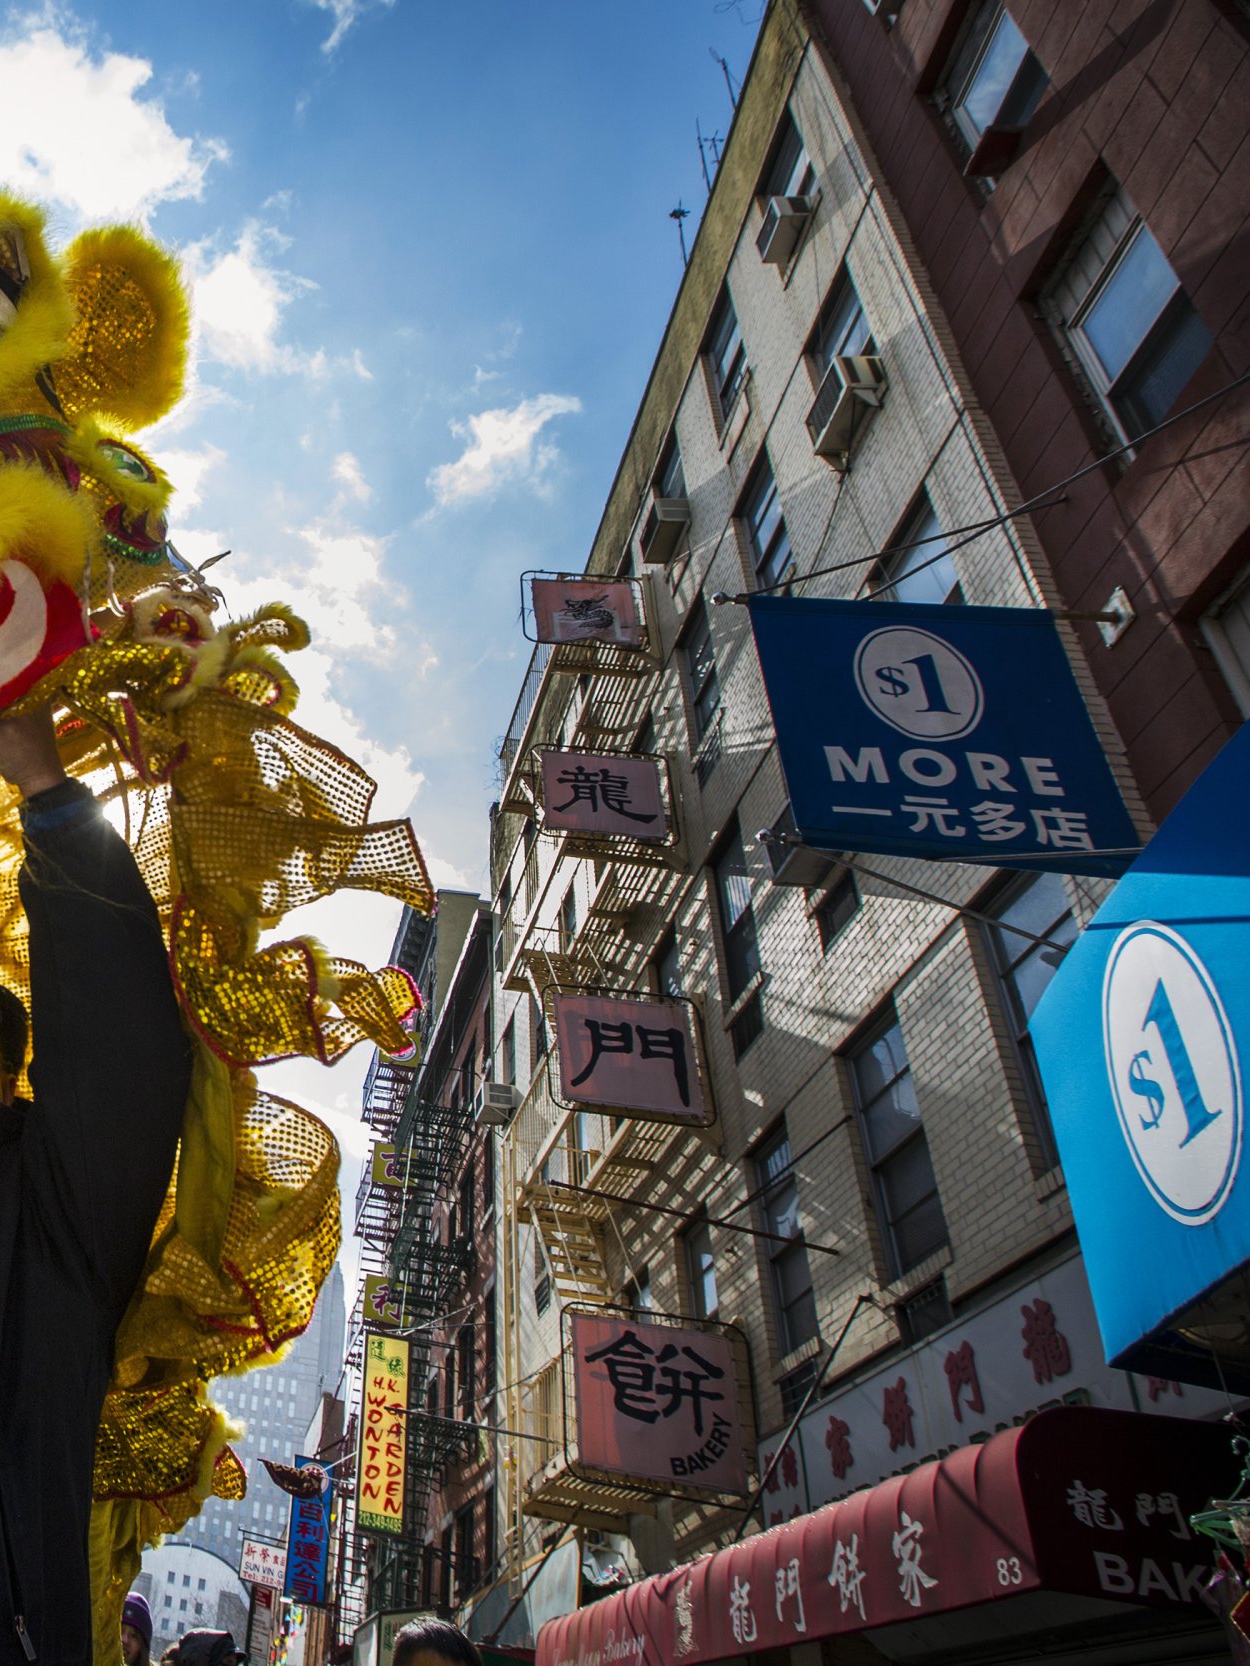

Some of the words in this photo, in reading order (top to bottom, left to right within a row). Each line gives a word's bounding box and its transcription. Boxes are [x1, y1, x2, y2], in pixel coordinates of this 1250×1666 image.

[874, 654, 961, 715] $1
[551, 765, 657, 824] 龍
[823, 745, 1065, 796] MORE
[832, 795, 1094, 850] 一元多店
[570, 1017, 690, 1108] 門
[1129, 977, 1222, 1149] $1
[584, 1330, 725, 1437] 餅
[362, 1392, 386, 1500] WONTON
[384, 1403, 405, 1515] GARDEN
[671, 1411, 733, 1476] BAKERY
[244, 1562, 260, 1574] SUN
[262, 1565, 273, 1577] VIN
[293, 1500, 324, 1603] 百利達公司
[729, 1511, 939, 1645] 龍門餅家
[996, 1557, 1023, 1586] 83
[1093, 1551, 1210, 1604] BAK
